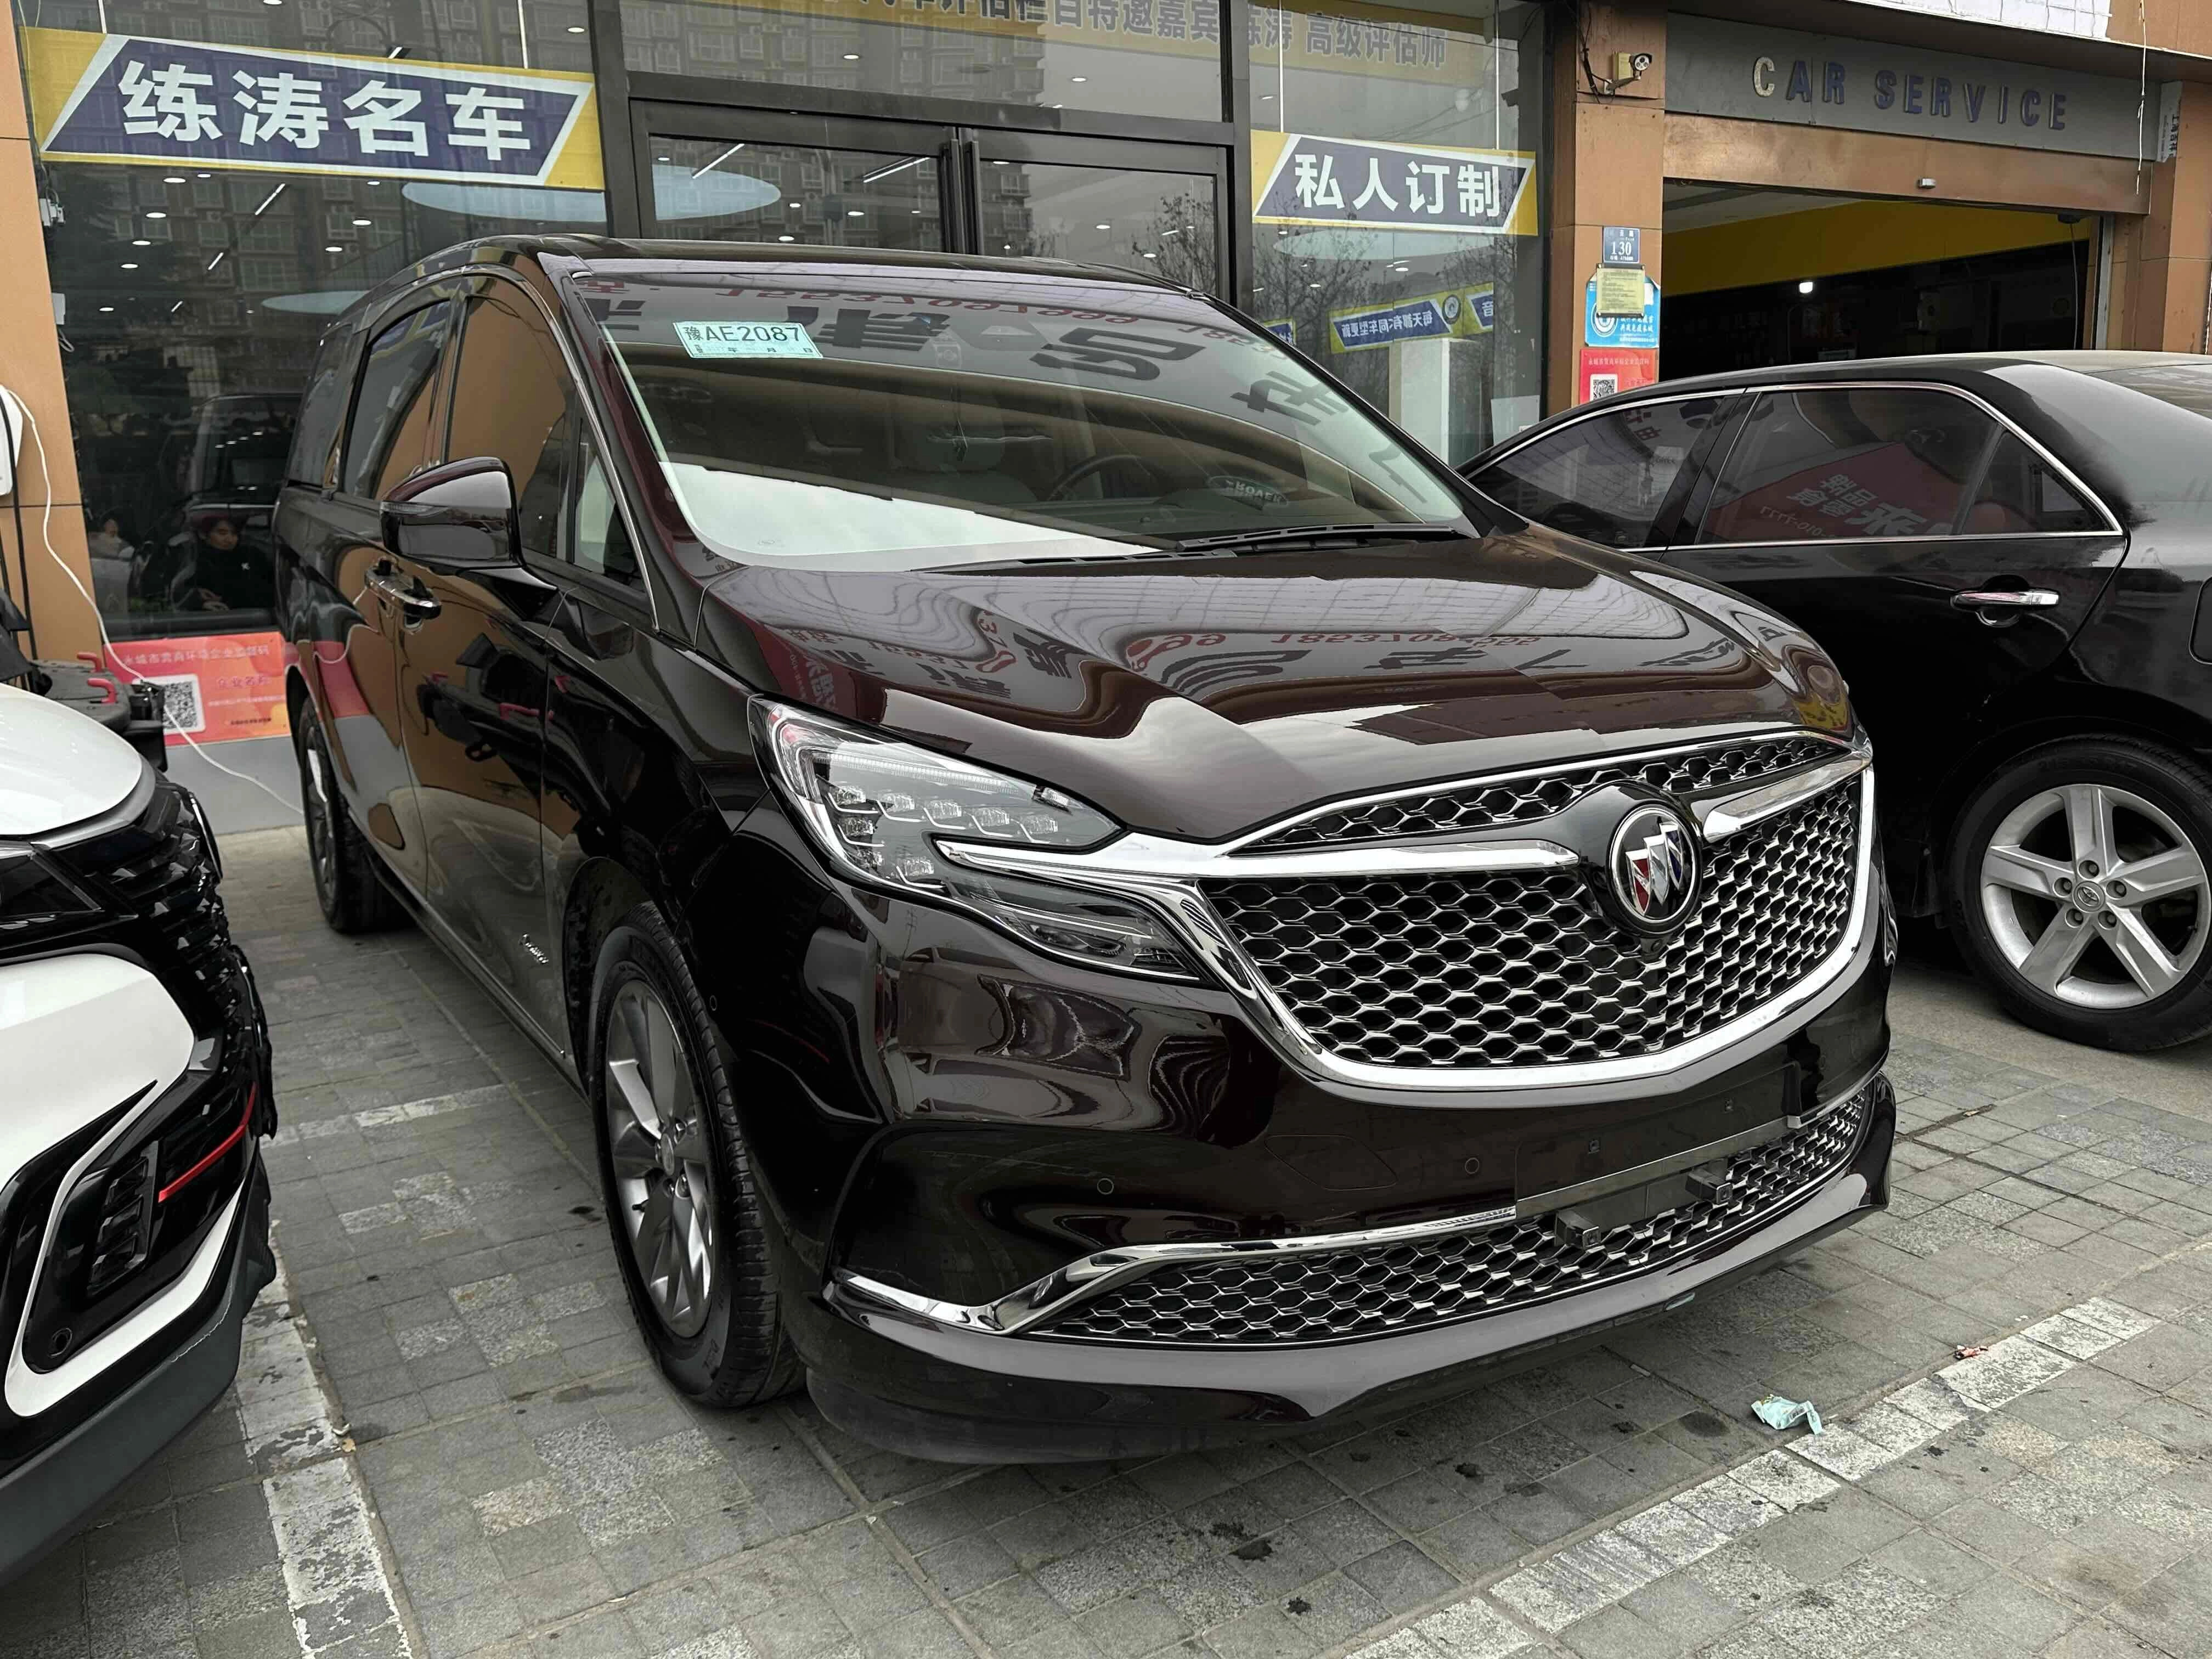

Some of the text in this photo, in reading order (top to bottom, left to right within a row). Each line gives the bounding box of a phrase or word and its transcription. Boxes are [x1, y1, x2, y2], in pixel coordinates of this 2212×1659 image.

[1306, 12, 1448, 70] 高级评估师
[118, 59, 532, 161] 练涛名车
[1753, 56, 2067, 131] CAR SERVICE
[1294, 153, 1500, 217] 私人订制
[1611, 241, 1632, 256] 130
[684, 325, 800, 342] 豫AE2087
